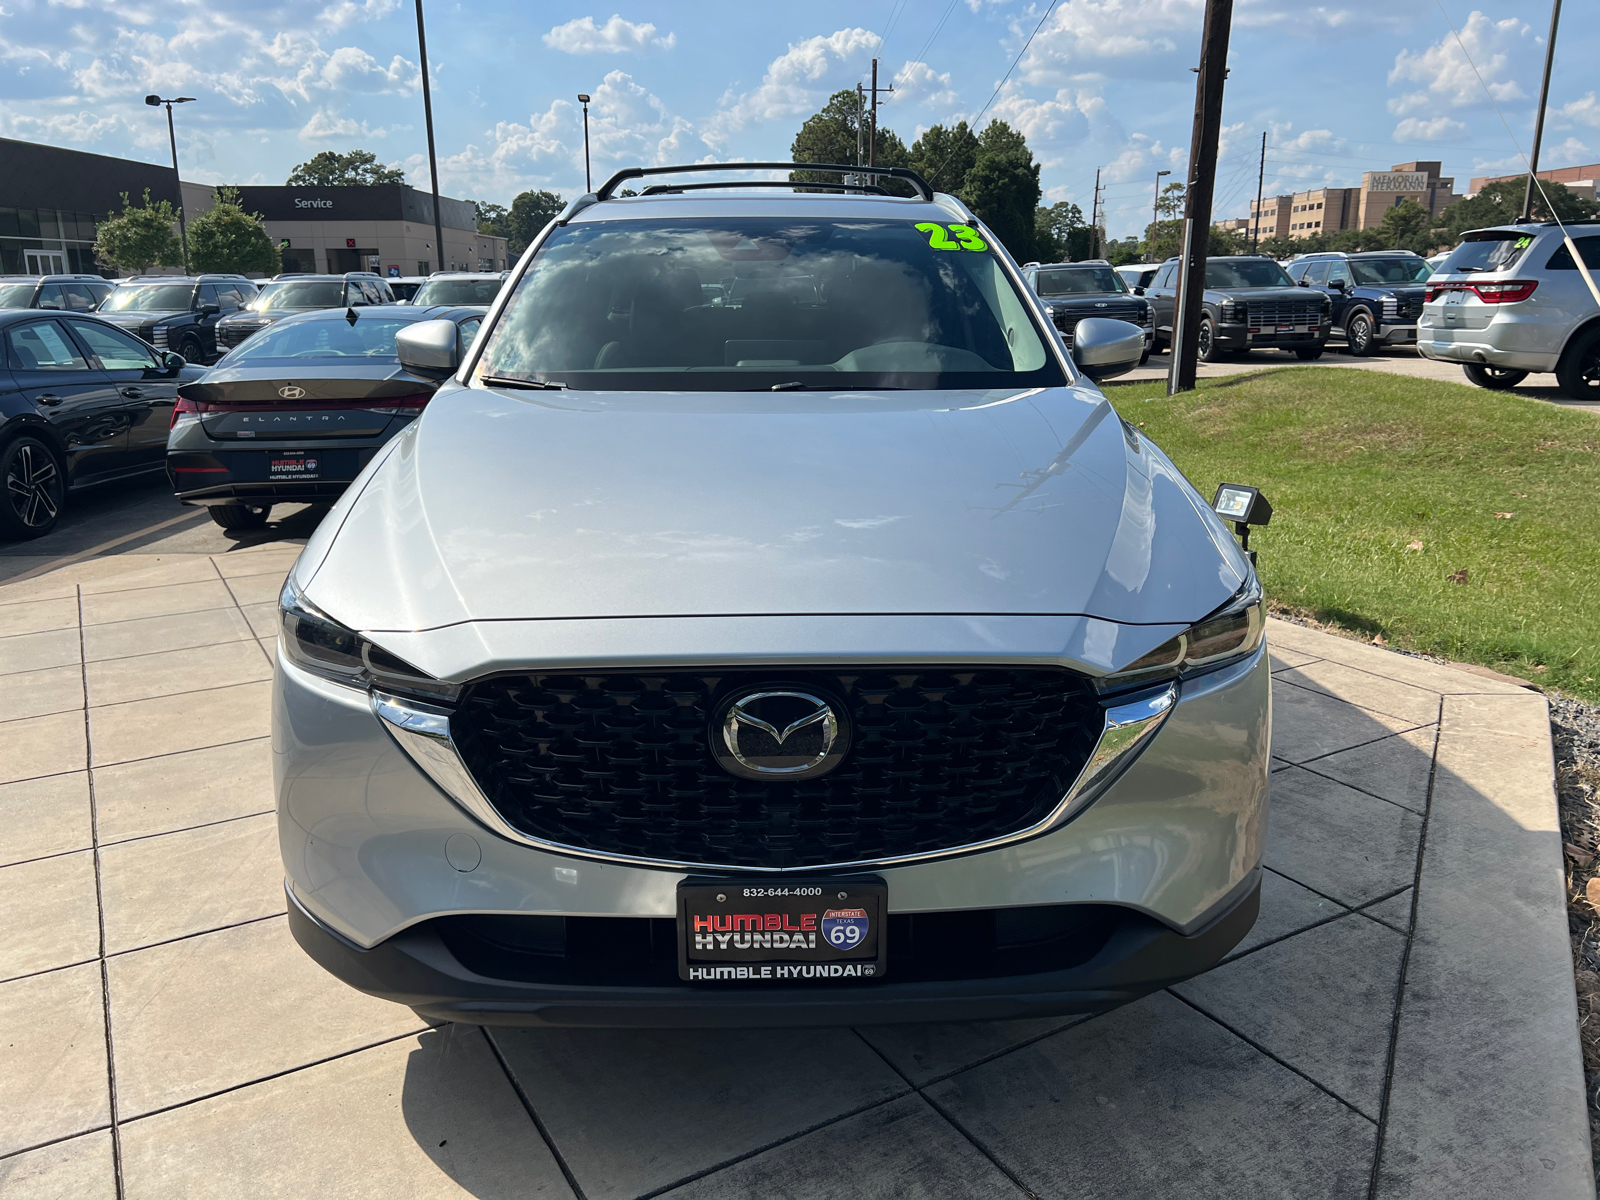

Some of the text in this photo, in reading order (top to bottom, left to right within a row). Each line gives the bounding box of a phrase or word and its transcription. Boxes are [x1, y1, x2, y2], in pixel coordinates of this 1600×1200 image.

[1373, 174, 1425, 184] MEMORIAL
[1371, 182, 1426, 191] HERMANN
[294, 198, 333, 209] Service
[914, 222, 989, 252] 23
[1514, 237, 1531, 248] 24
[743, 888, 822, 897] 832-644-4000
[694, 914, 816, 932] HUMBLE
[695, 932, 816, 950] HYUNDAI
[830, 925, 860, 945] 69
[690, 964, 861, 979] HUMBLE HYUNDAI
